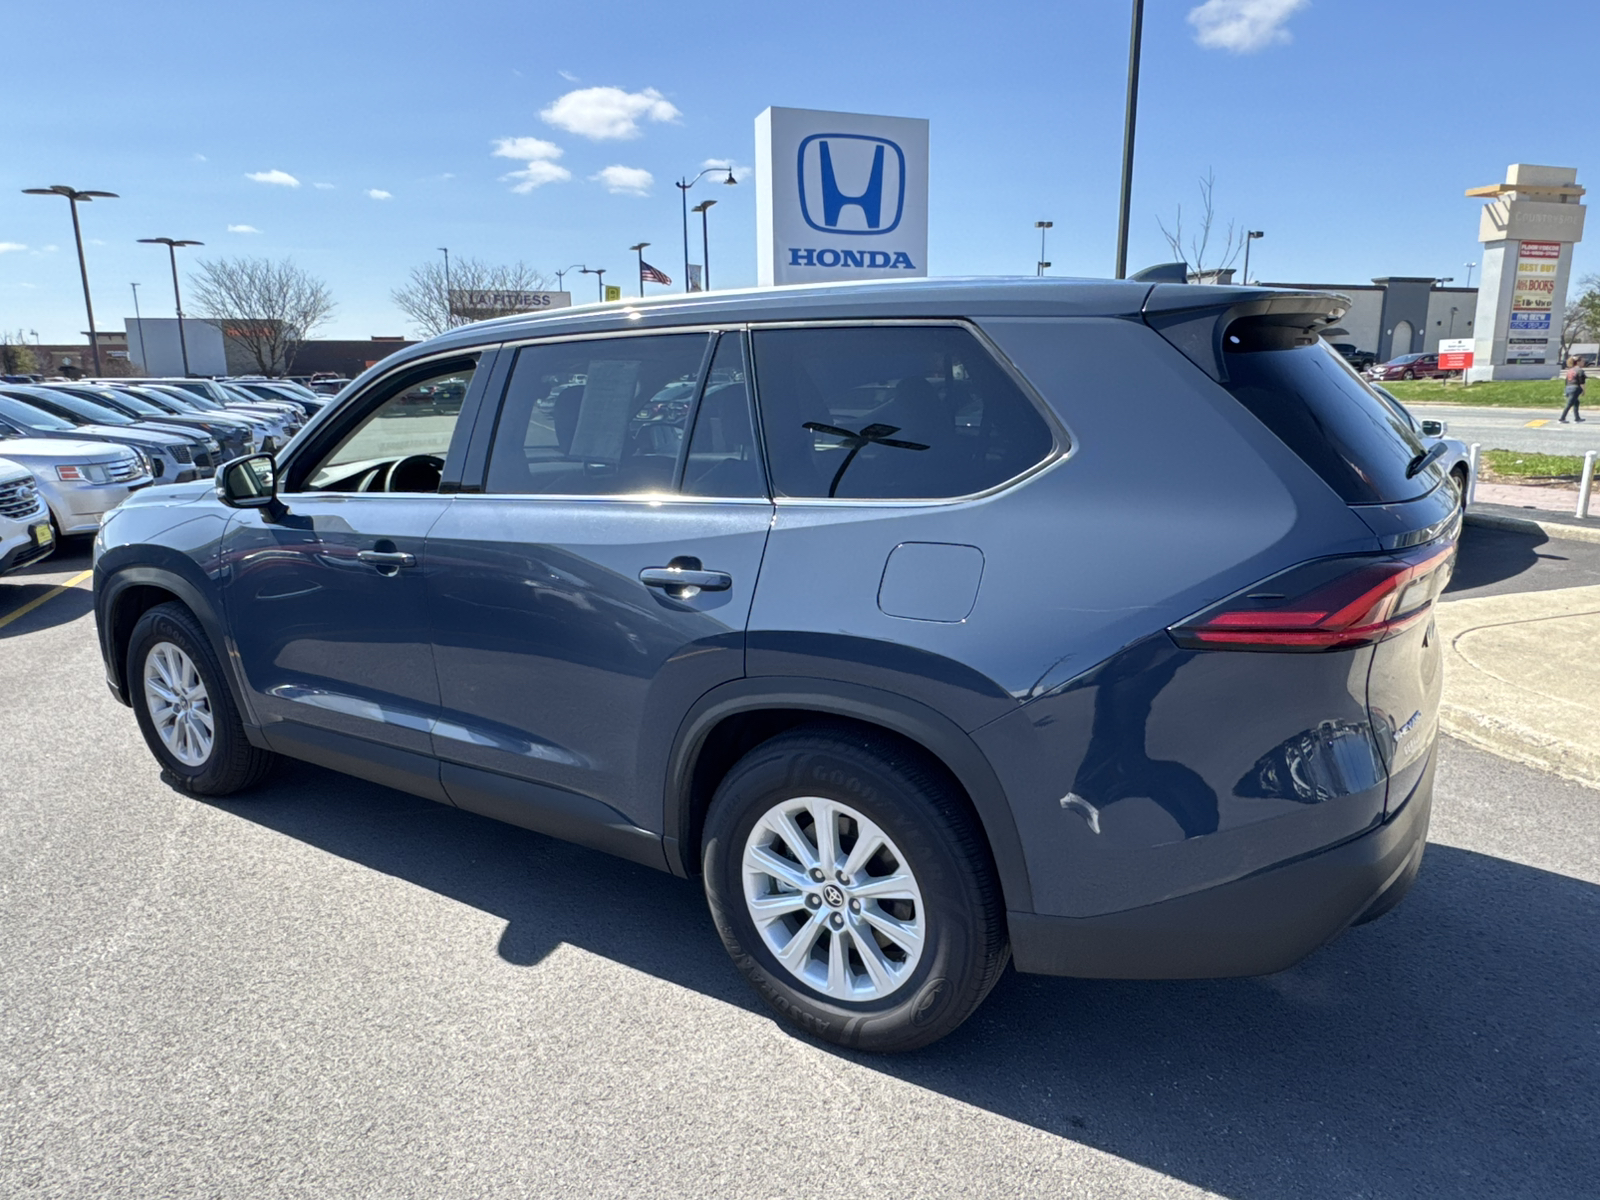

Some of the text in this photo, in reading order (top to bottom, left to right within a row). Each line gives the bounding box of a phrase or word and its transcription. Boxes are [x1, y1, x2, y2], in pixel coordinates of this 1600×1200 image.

[788, 248, 916, 269] HONDA
[1519, 263, 1556, 273] BEST BUY
[1529, 279, 1554, 294] BOOKS
[493, 294, 551, 306] FITNESS
